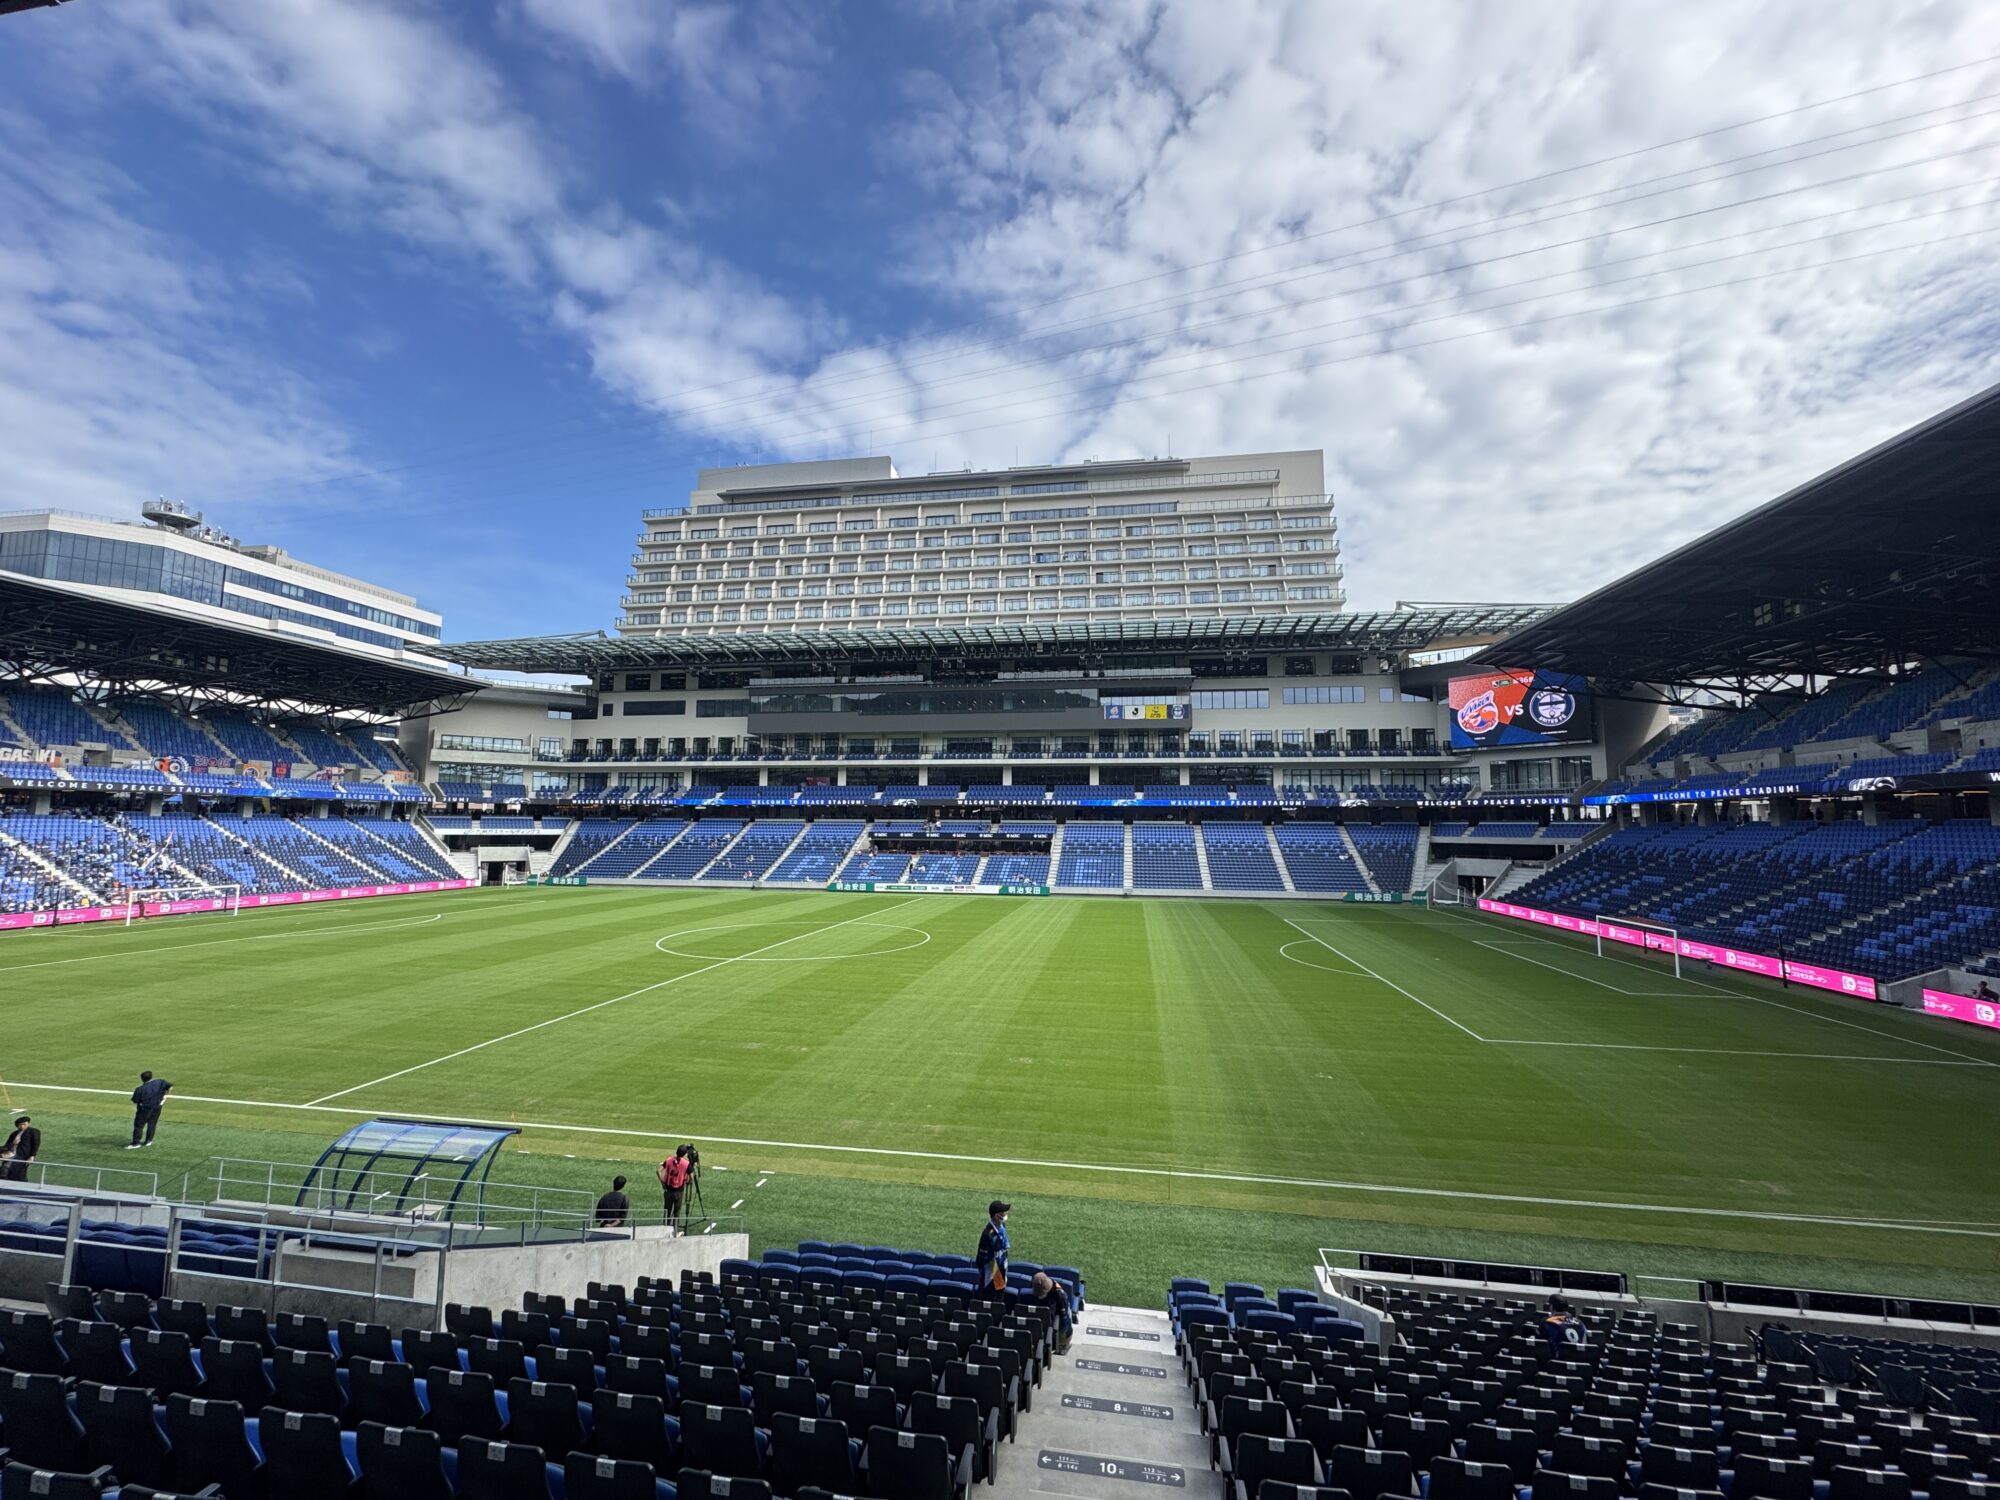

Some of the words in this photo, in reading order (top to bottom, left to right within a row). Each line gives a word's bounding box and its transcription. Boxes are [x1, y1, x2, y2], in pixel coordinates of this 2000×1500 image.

[1504, 704, 1524, 716] VS
[13, 779, 88, 789] WELCOME
[122, 784, 162, 792] PEACE
[170, 786, 228, 794] STADIUM!
[1695, 790, 1706, 798] TO
[1710, 789, 1740, 797] PEACE
[1745, 784, 1800, 795] STADIUM!
[1008, 886, 1041, 894] 明治安田
[1354, 893, 1392, 901] 明治安田
[1113, 1403, 1121, 1412] 8
[1099, 1462, 1117, 1475] 10
